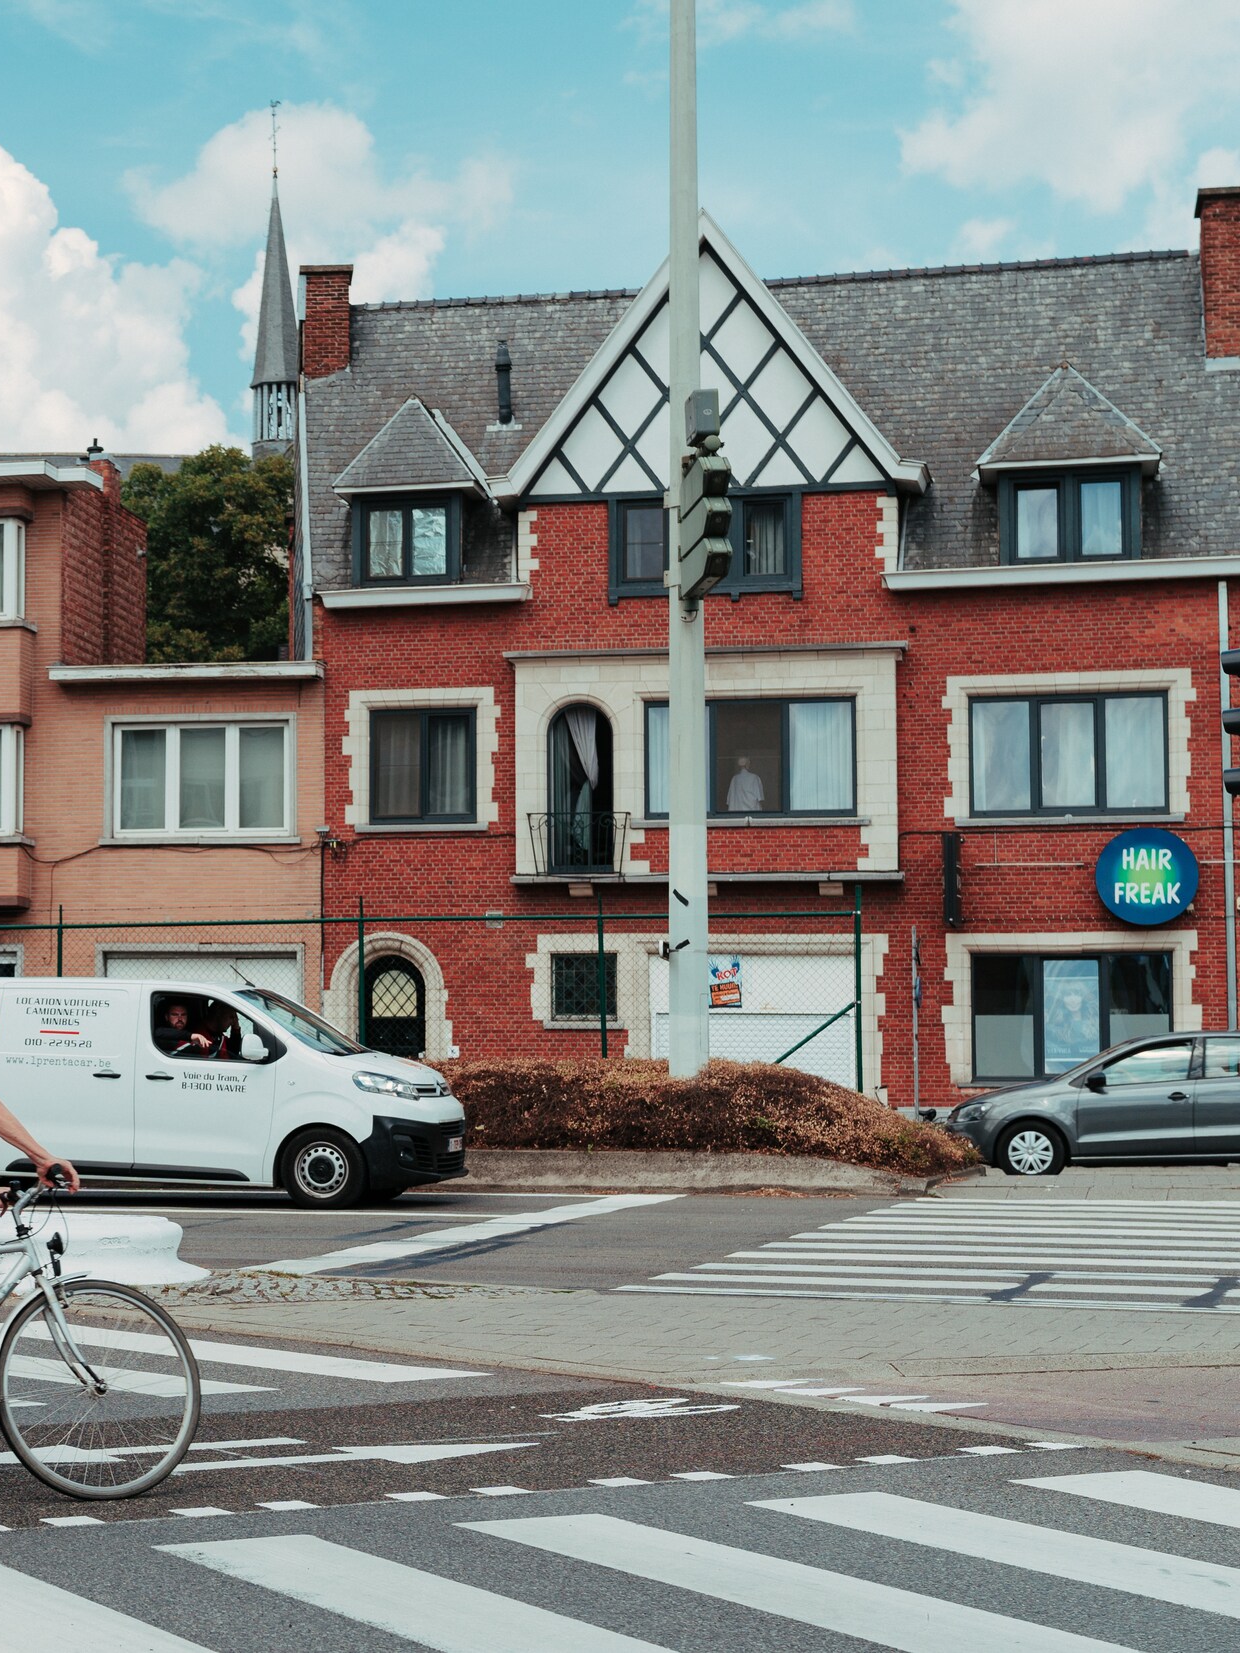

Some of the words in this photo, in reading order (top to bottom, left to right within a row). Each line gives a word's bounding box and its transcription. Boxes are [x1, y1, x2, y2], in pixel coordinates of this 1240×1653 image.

[1122, 847, 1172, 871] HAIR
[1114, 881, 1181, 905] FREAK
[716, 967, 738, 980] KOT
[16, 997, 61, 1006] LOCATION
[64, 998, 110, 1008] VOITURES
[25, 1007, 98, 1017] CAMIONNETTES
[41, 1017, 80, 1026] MINIBUS
[5, 1056, 111, 1068] www.lprentacar.be
[183, 1071, 202, 1079] Voie
[203, 1072, 215, 1081] du
[217, 1073, 240, 1083] Tram,
[242, 1075, 248, 1083] 7
[181, 1081, 212, 1091] B-1300
[216, 1084, 247, 1093] WAVRE
